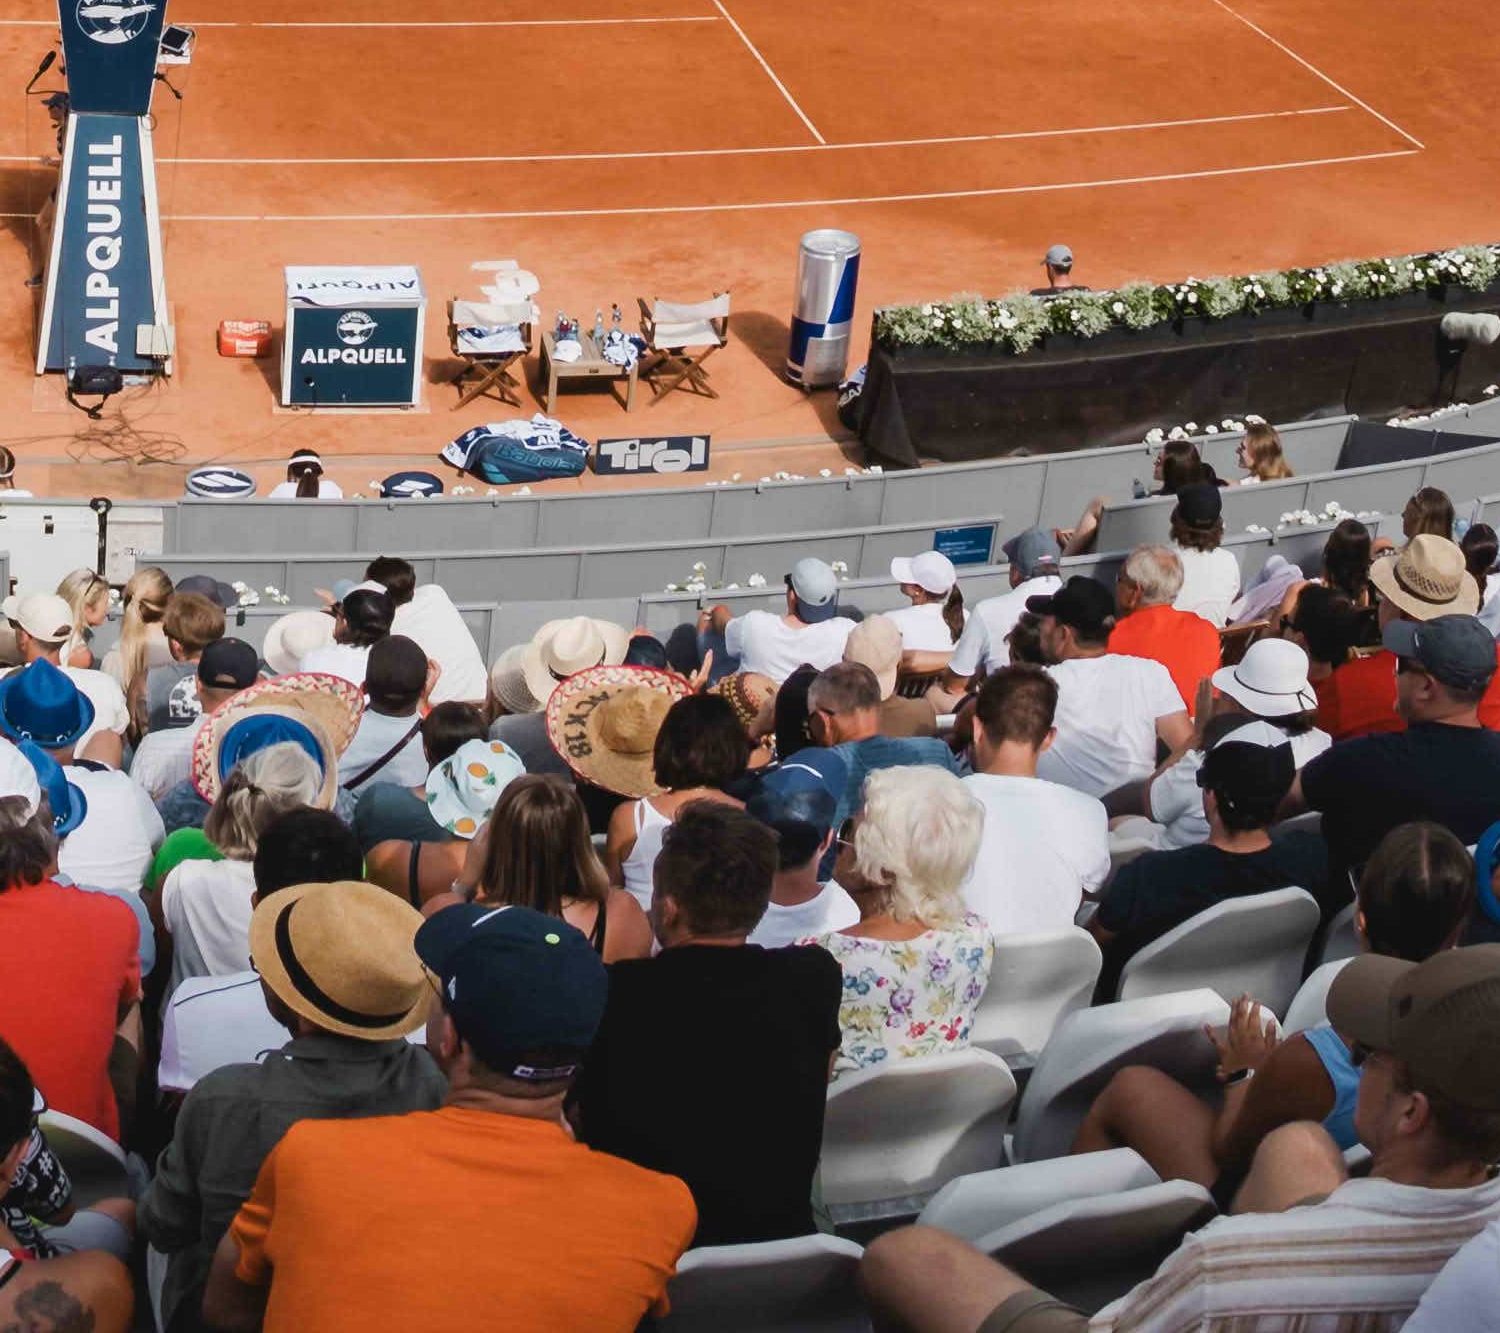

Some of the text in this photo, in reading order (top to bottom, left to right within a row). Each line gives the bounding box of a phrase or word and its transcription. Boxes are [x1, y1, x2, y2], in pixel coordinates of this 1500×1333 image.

[85, 134, 123, 354] ALPQUELL
[300, 347, 407, 365] ALPQUELL
[599, 436, 706, 474] Tirol
